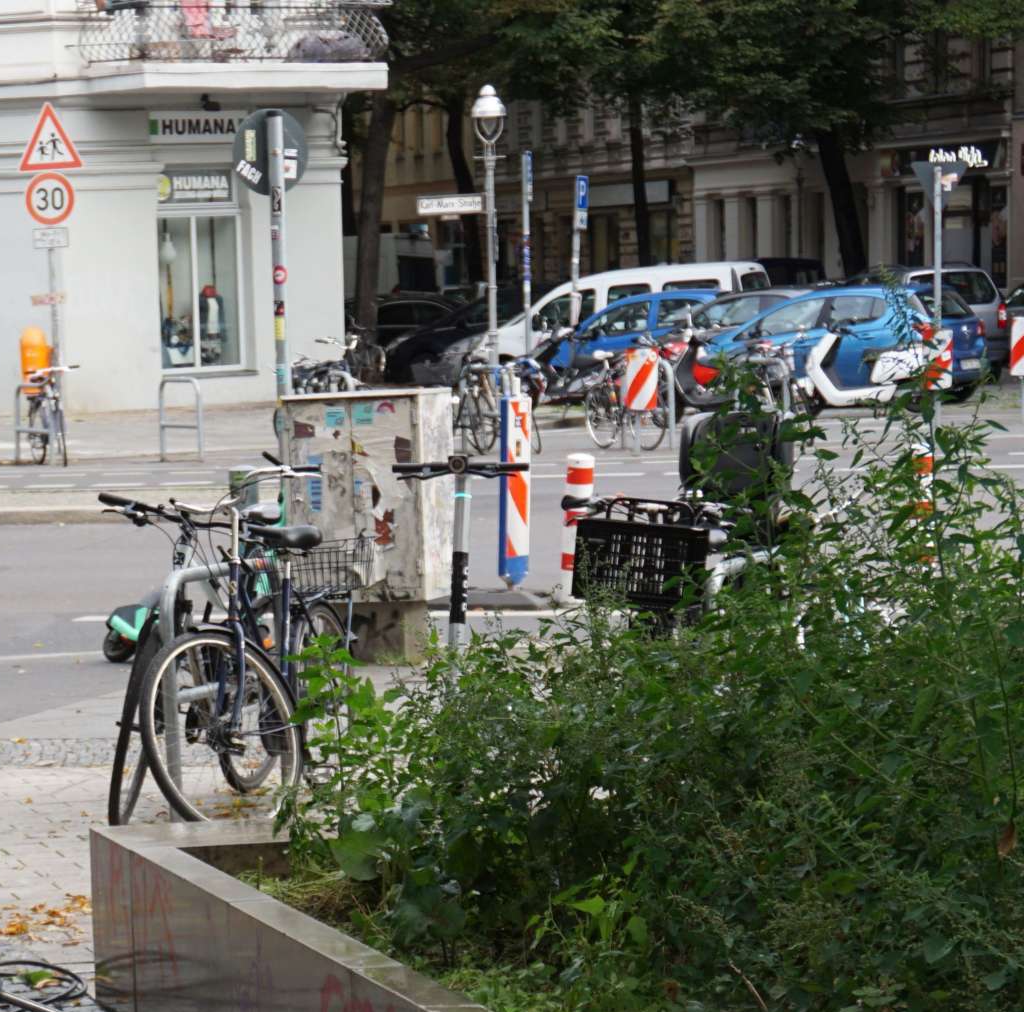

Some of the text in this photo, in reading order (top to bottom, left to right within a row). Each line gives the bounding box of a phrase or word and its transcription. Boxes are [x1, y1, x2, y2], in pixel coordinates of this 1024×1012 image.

[162, 118, 236, 135] HUMANA
[172, 176, 229, 190] HUMANA
[579, 180, 587, 205] P
[36, 187, 64, 211] 30
